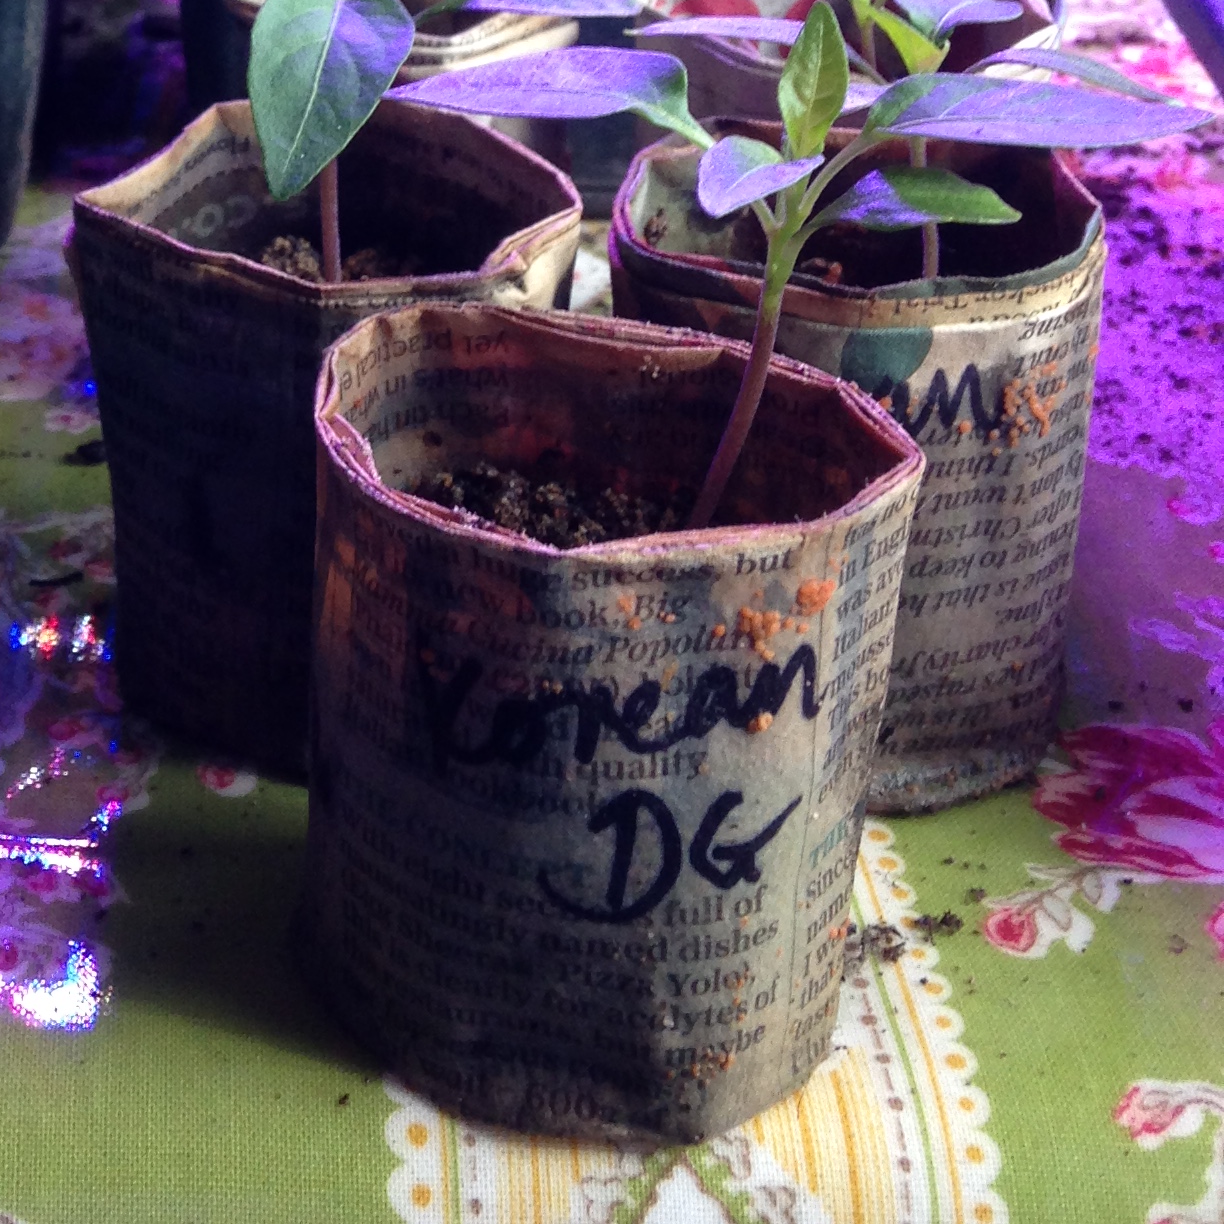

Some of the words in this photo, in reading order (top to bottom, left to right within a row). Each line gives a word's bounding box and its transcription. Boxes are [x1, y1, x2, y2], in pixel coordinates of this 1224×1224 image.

[356, 329, 453, 388] practical
[463, 330, 510, 357] yet
[932, 484, 1008, 516] want
[736, 545, 794, 577] but
[838, 558, 857, 591] in
[909, 552, 976, 580] keep
[978, 550, 1008, 570] to
[634, 589, 693, 626] Big
[836, 581, 873, 623] was
[932, 583, 992, 612] that
[993, 577, 1020, 601] is
[927, 635, 1022, 674] charity
[418, 628, 824, 774] Korean
[536, 788, 803, 924] DG
[665, 894, 724, 927] full
[733, 883, 769, 919] of
[678, 919, 780, 964] dishes
[754, 971, 781, 1011] of
